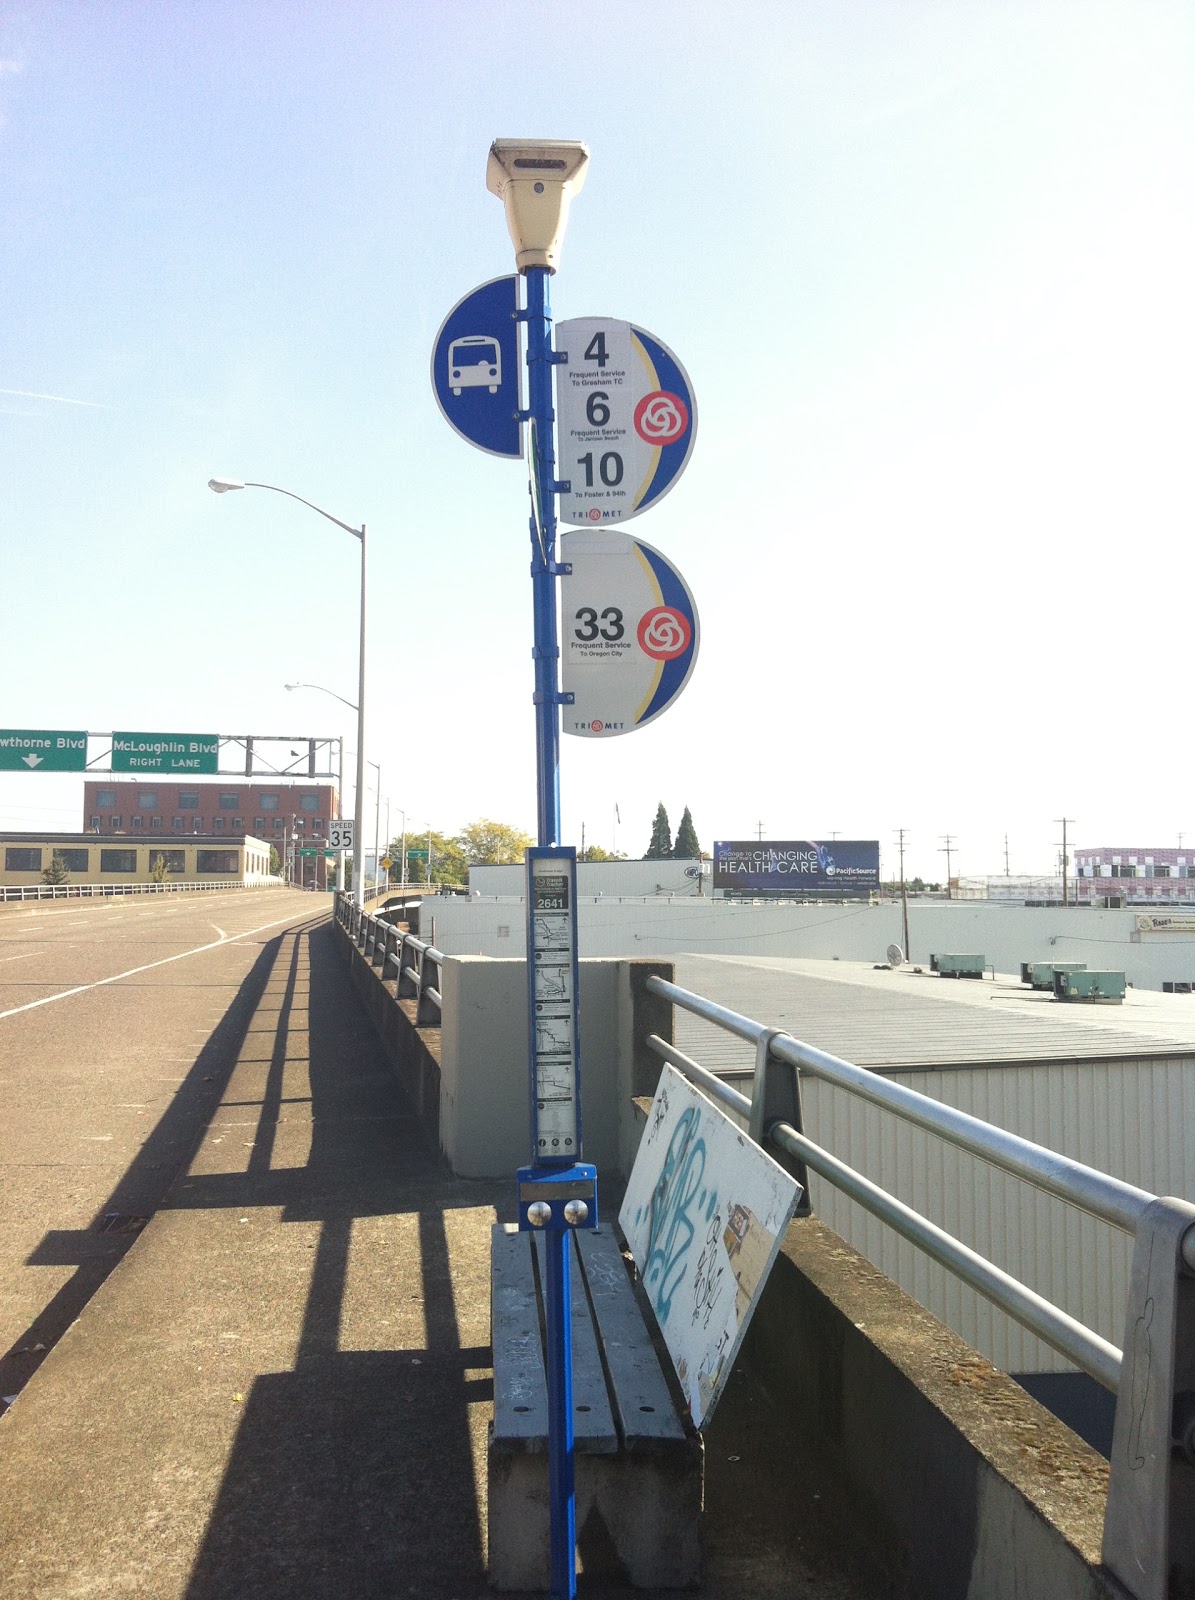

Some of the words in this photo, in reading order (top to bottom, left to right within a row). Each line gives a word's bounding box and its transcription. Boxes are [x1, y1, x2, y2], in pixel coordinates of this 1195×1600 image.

[584, 331, 610, 368] 4
[569, 371, 599, 379] Frequent
[586, 391, 611, 427] 6
[577, 451, 624, 487] 10
[574, 606, 625, 642] 33
[571, 641, 604, 650] Frequent
[604, 641, 632, 649] Service
[610, 650, 623, 658] City
[57, 737, 85, 749] Blvd
[113, 740, 185, 755] McLoughlin
[189, 742, 218, 754] Blvd
[129, 757, 162, 766] RIGHT
[171, 758, 201, 768] LANE
[331, 830, 352, 847] 35
[752, 850, 818, 861] CHANGING
[718, 861, 771, 873] HEALTH
[776, 861, 818, 874] CARE
[836, 867, 877, 876] PacificSource
[537, 898, 563, 909] 2641
